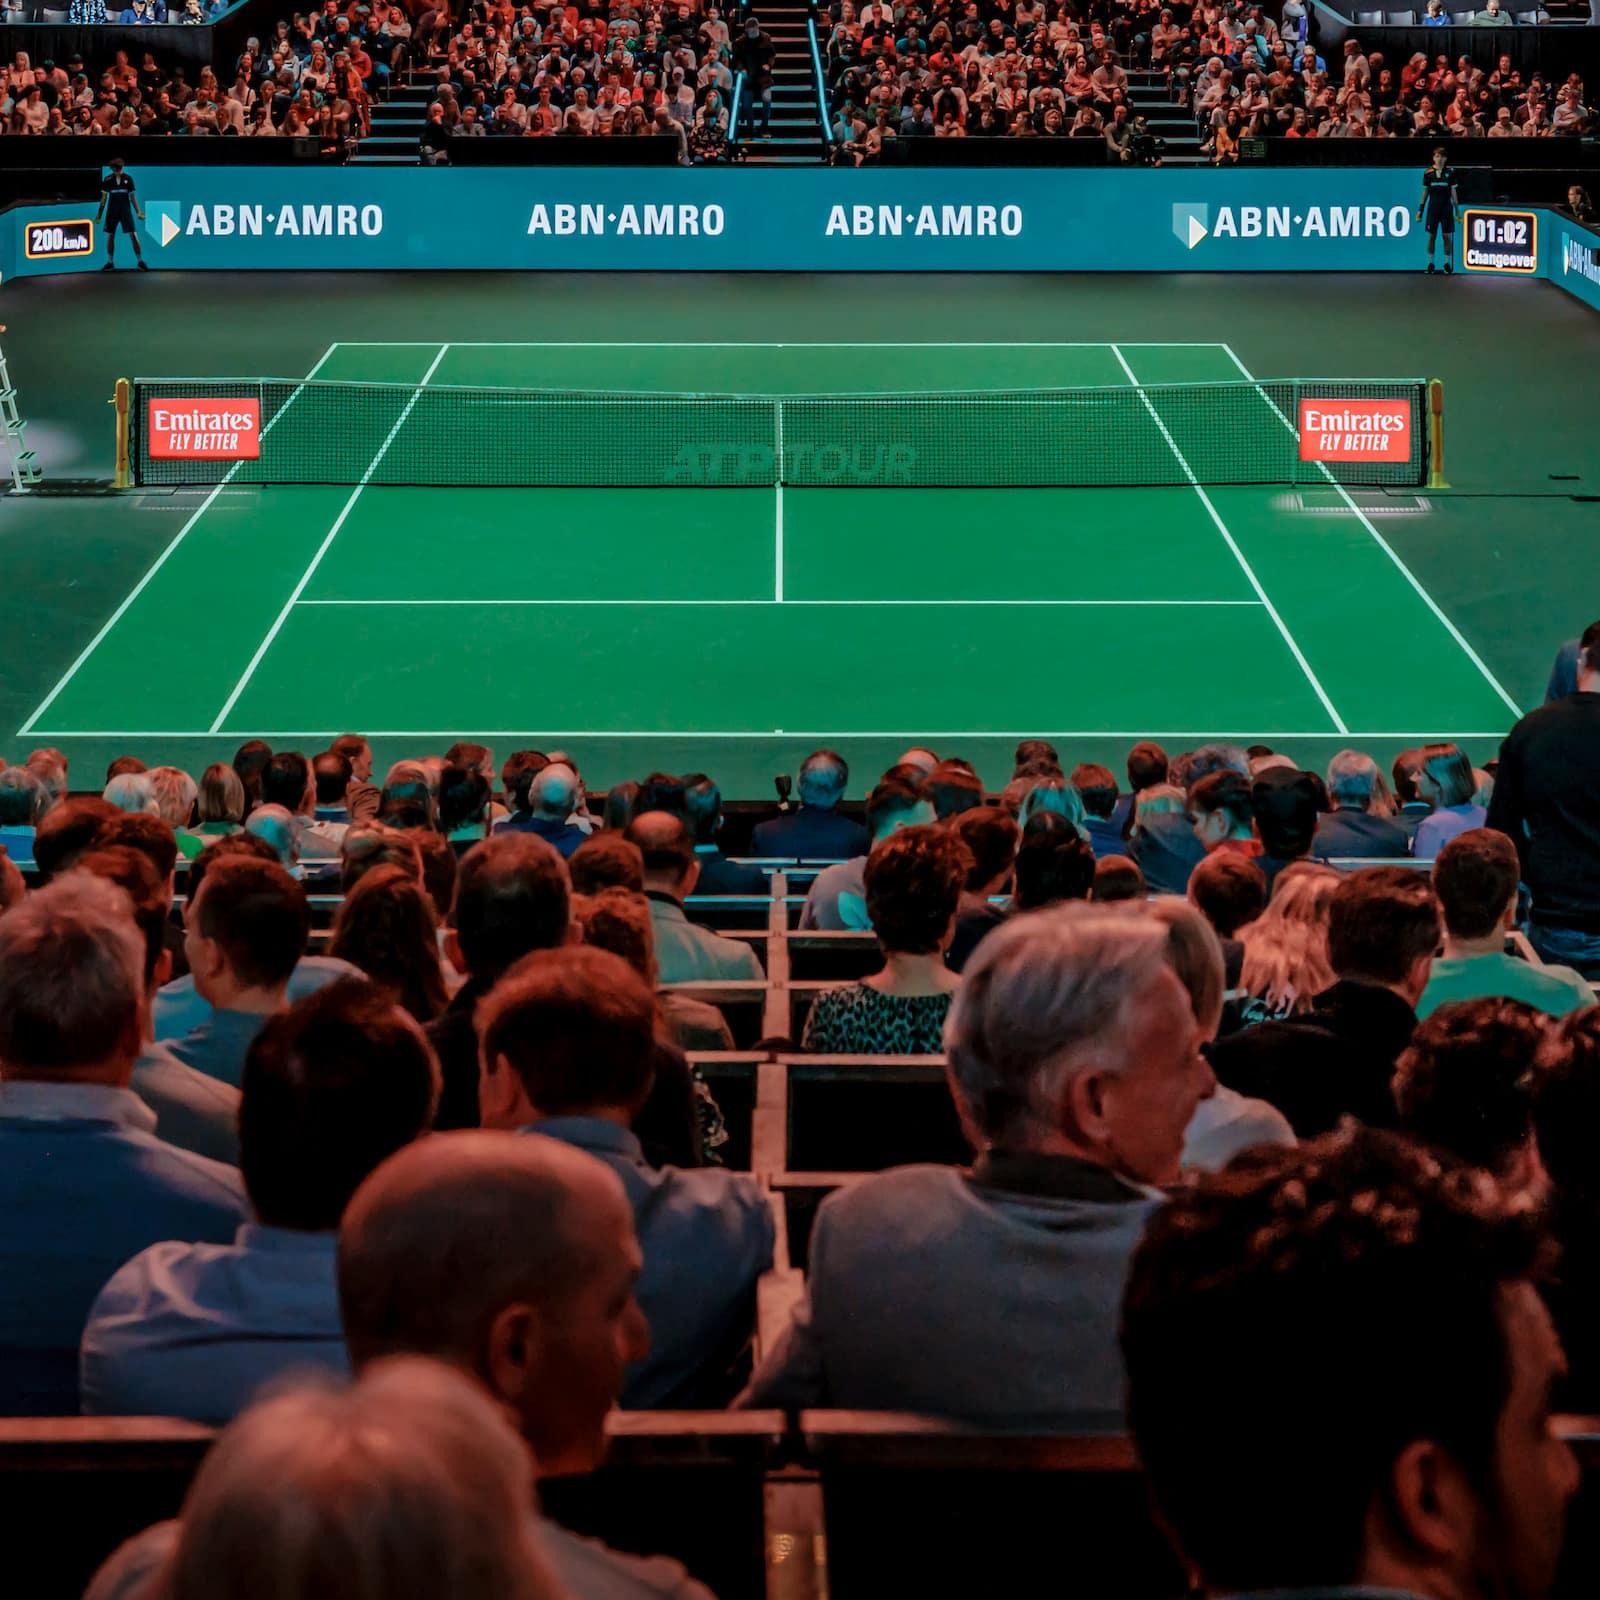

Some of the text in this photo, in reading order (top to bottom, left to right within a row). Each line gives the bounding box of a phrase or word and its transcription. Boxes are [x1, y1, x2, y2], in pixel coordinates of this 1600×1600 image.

[32, 228, 88, 252] 200 km/h
[1474, 220, 1526, 244] 01:02
[1467, 248, 1537, 269] Changeover
[154, 410, 255, 432] Emirates
[1305, 410, 1404, 432] Emirates
[169, 434, 239, 450] FLY BETTER
[1319, 434, 1389, 451] FLY BETTER
